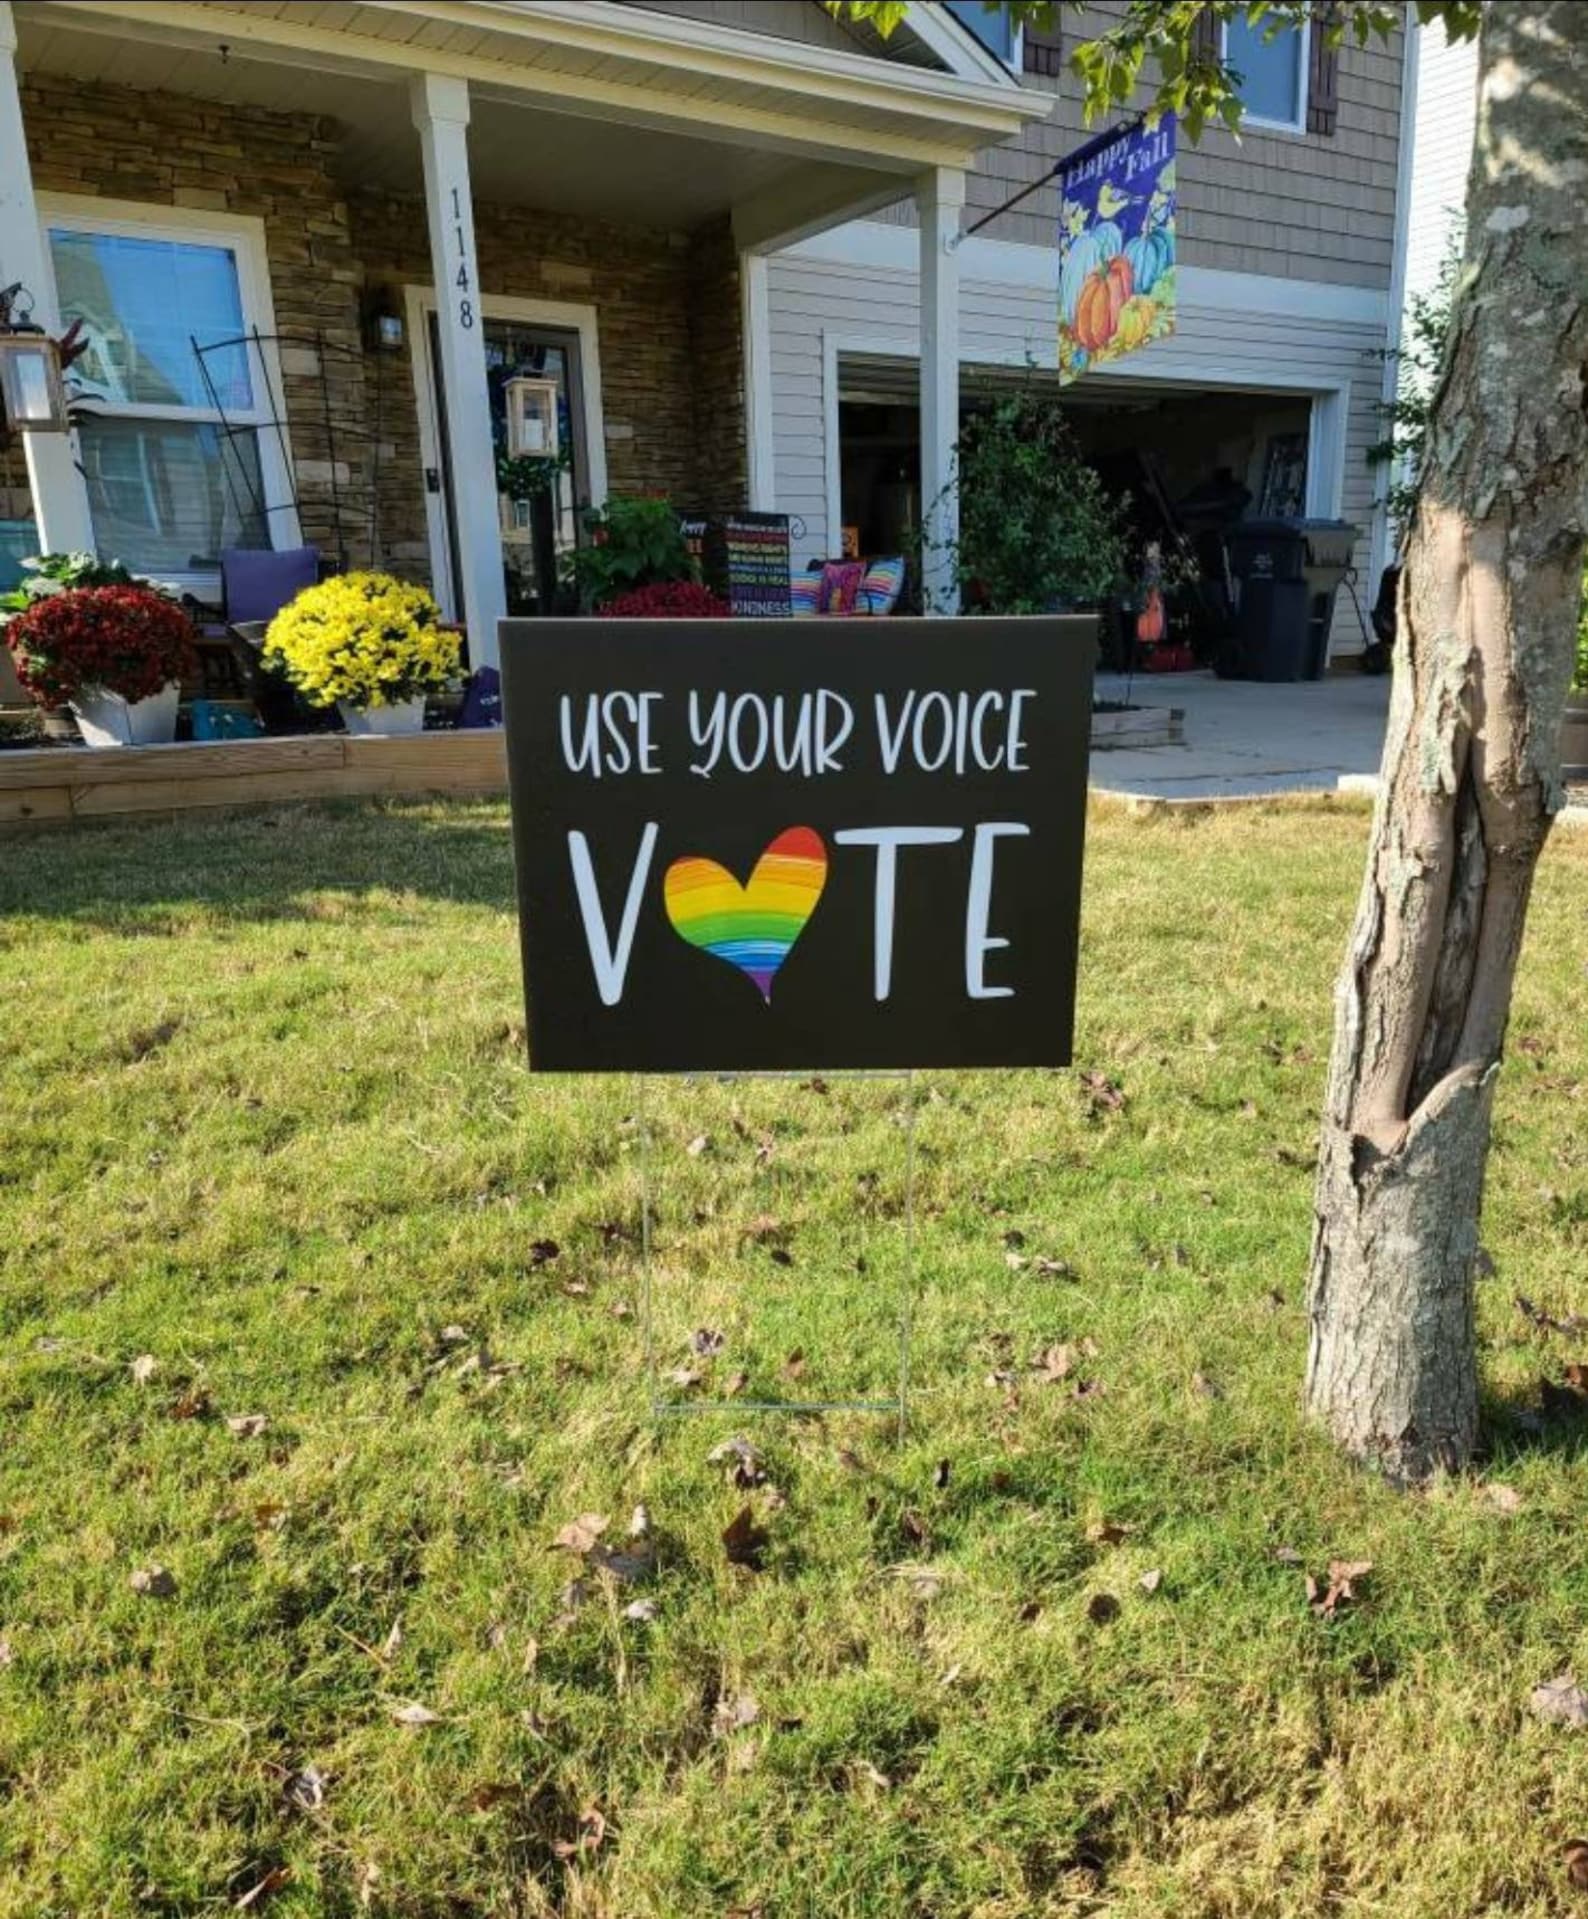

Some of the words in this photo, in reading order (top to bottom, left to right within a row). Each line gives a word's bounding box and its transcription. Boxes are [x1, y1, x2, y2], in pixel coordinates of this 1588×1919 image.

[1066, 136, 1130, 189] Happy
[1125, 131, 1168, 182] Fall
[451, 187, 473, 329] 1148
[731, 600, 790, 615] KINDNESS
[561, 690, 663, 778] USE
[689, 688, 854, 778] YOUR
[874, 689, 1037, 775] VOICE
